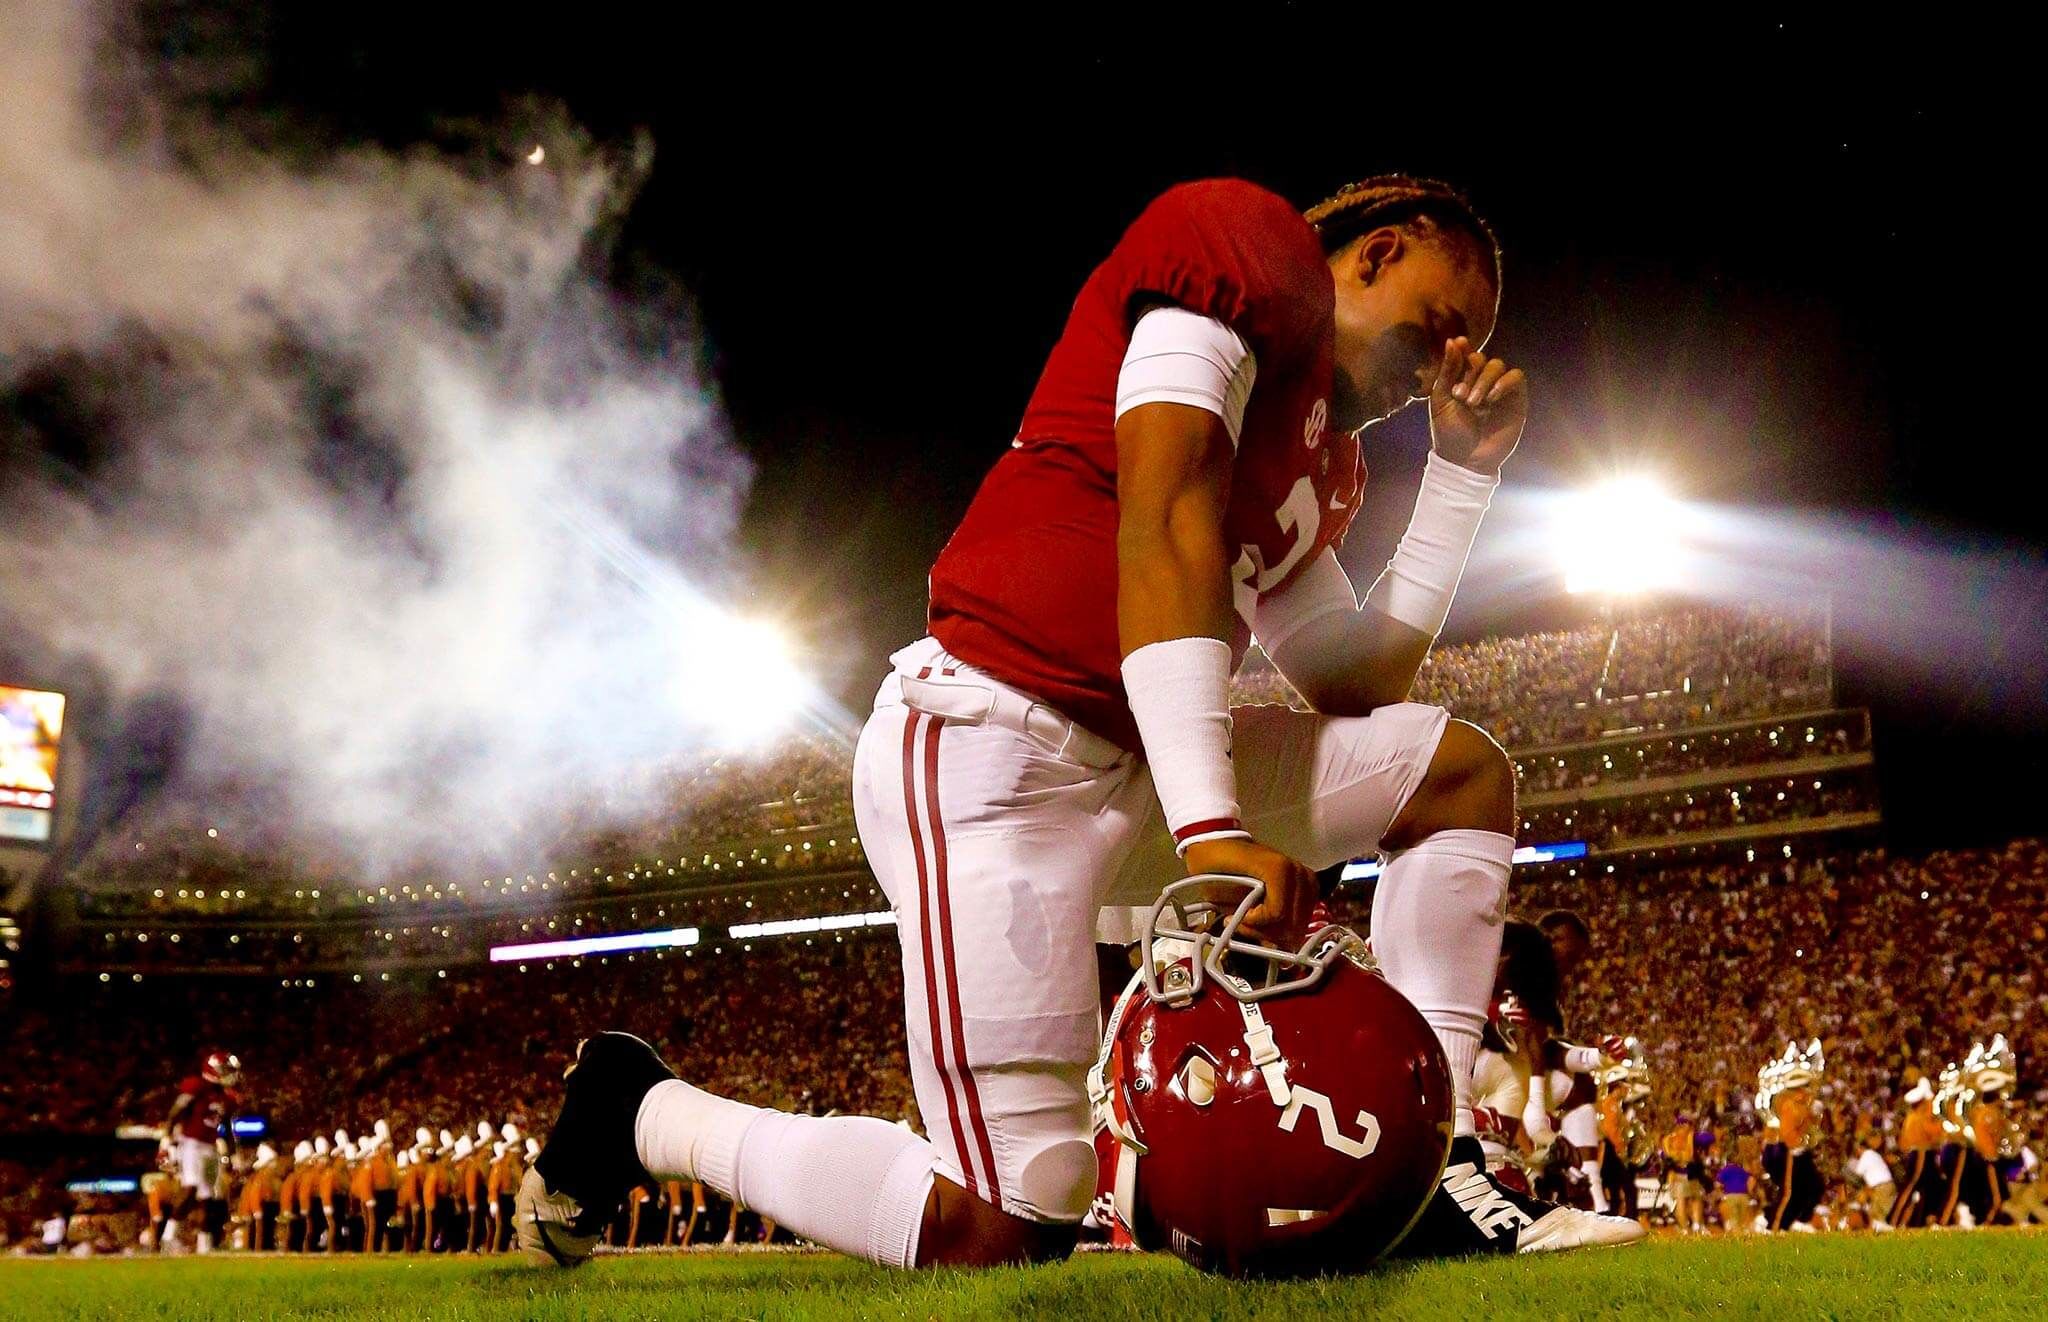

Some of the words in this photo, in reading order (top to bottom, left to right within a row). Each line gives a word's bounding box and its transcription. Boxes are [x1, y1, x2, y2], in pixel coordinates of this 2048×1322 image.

[1231, 475, 1320, 632] 2
[1278, 1084, 1381, 1159] 2
[1441, 1162, 1534, 1240] NIKE
